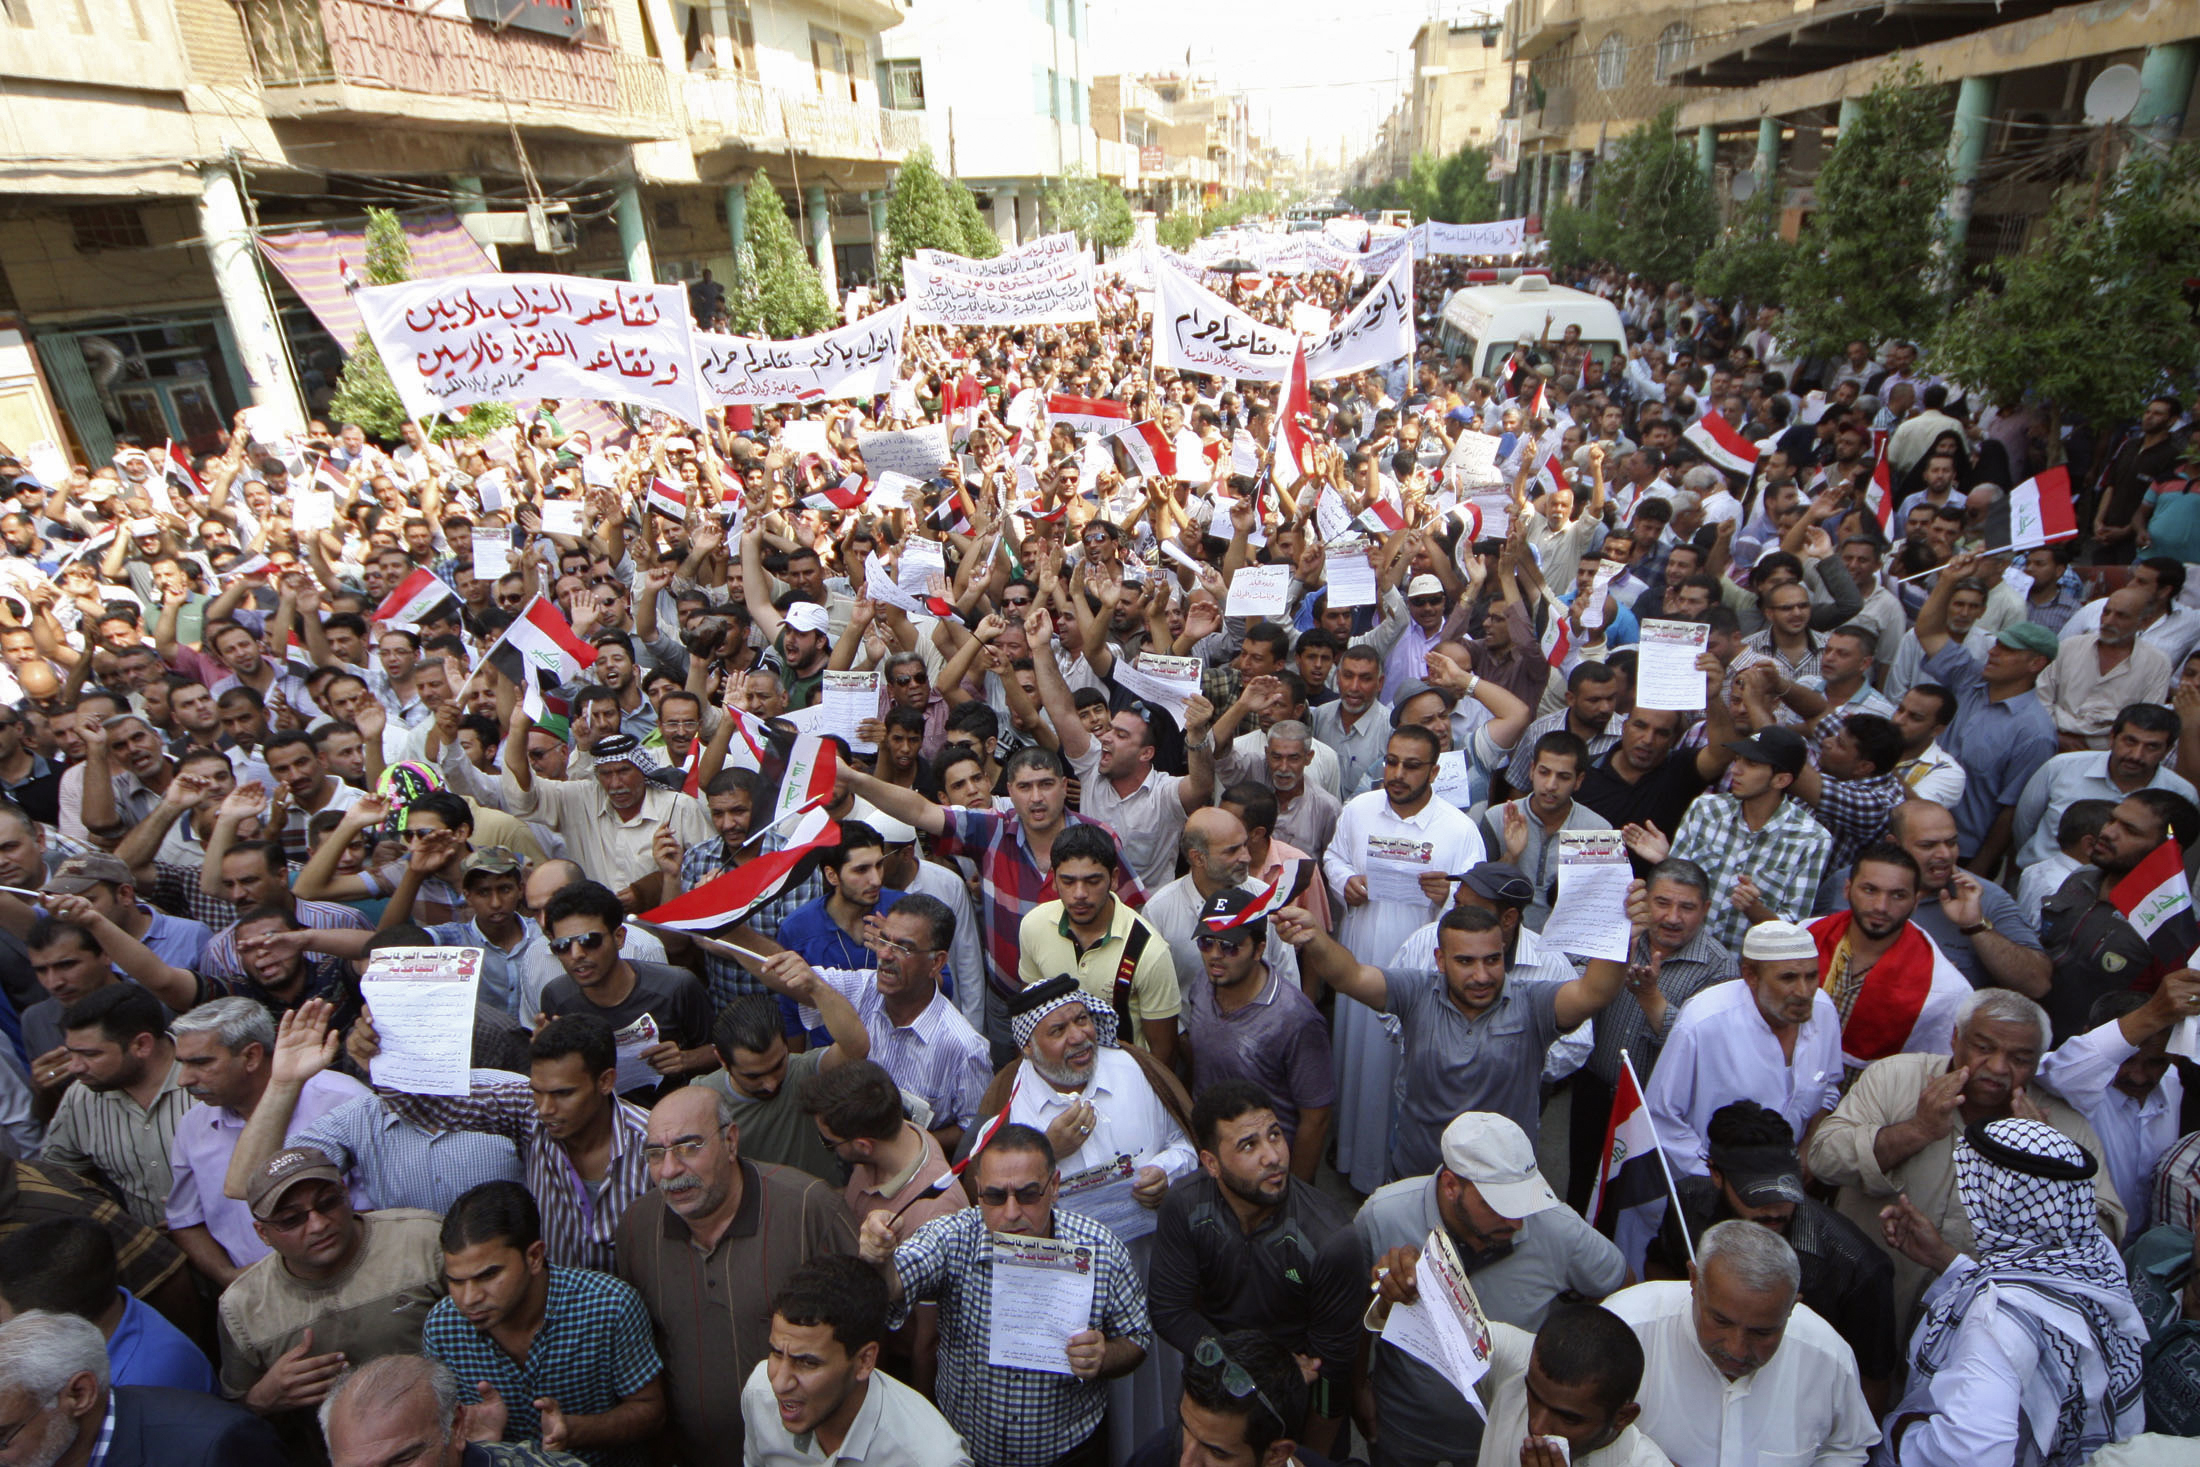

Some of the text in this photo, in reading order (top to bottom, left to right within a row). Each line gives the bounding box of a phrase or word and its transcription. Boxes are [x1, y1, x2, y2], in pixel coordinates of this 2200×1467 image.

[405, 282, 660, 333] تقاعد النواب ملايين
[1214, 898, 1228, 911] E
